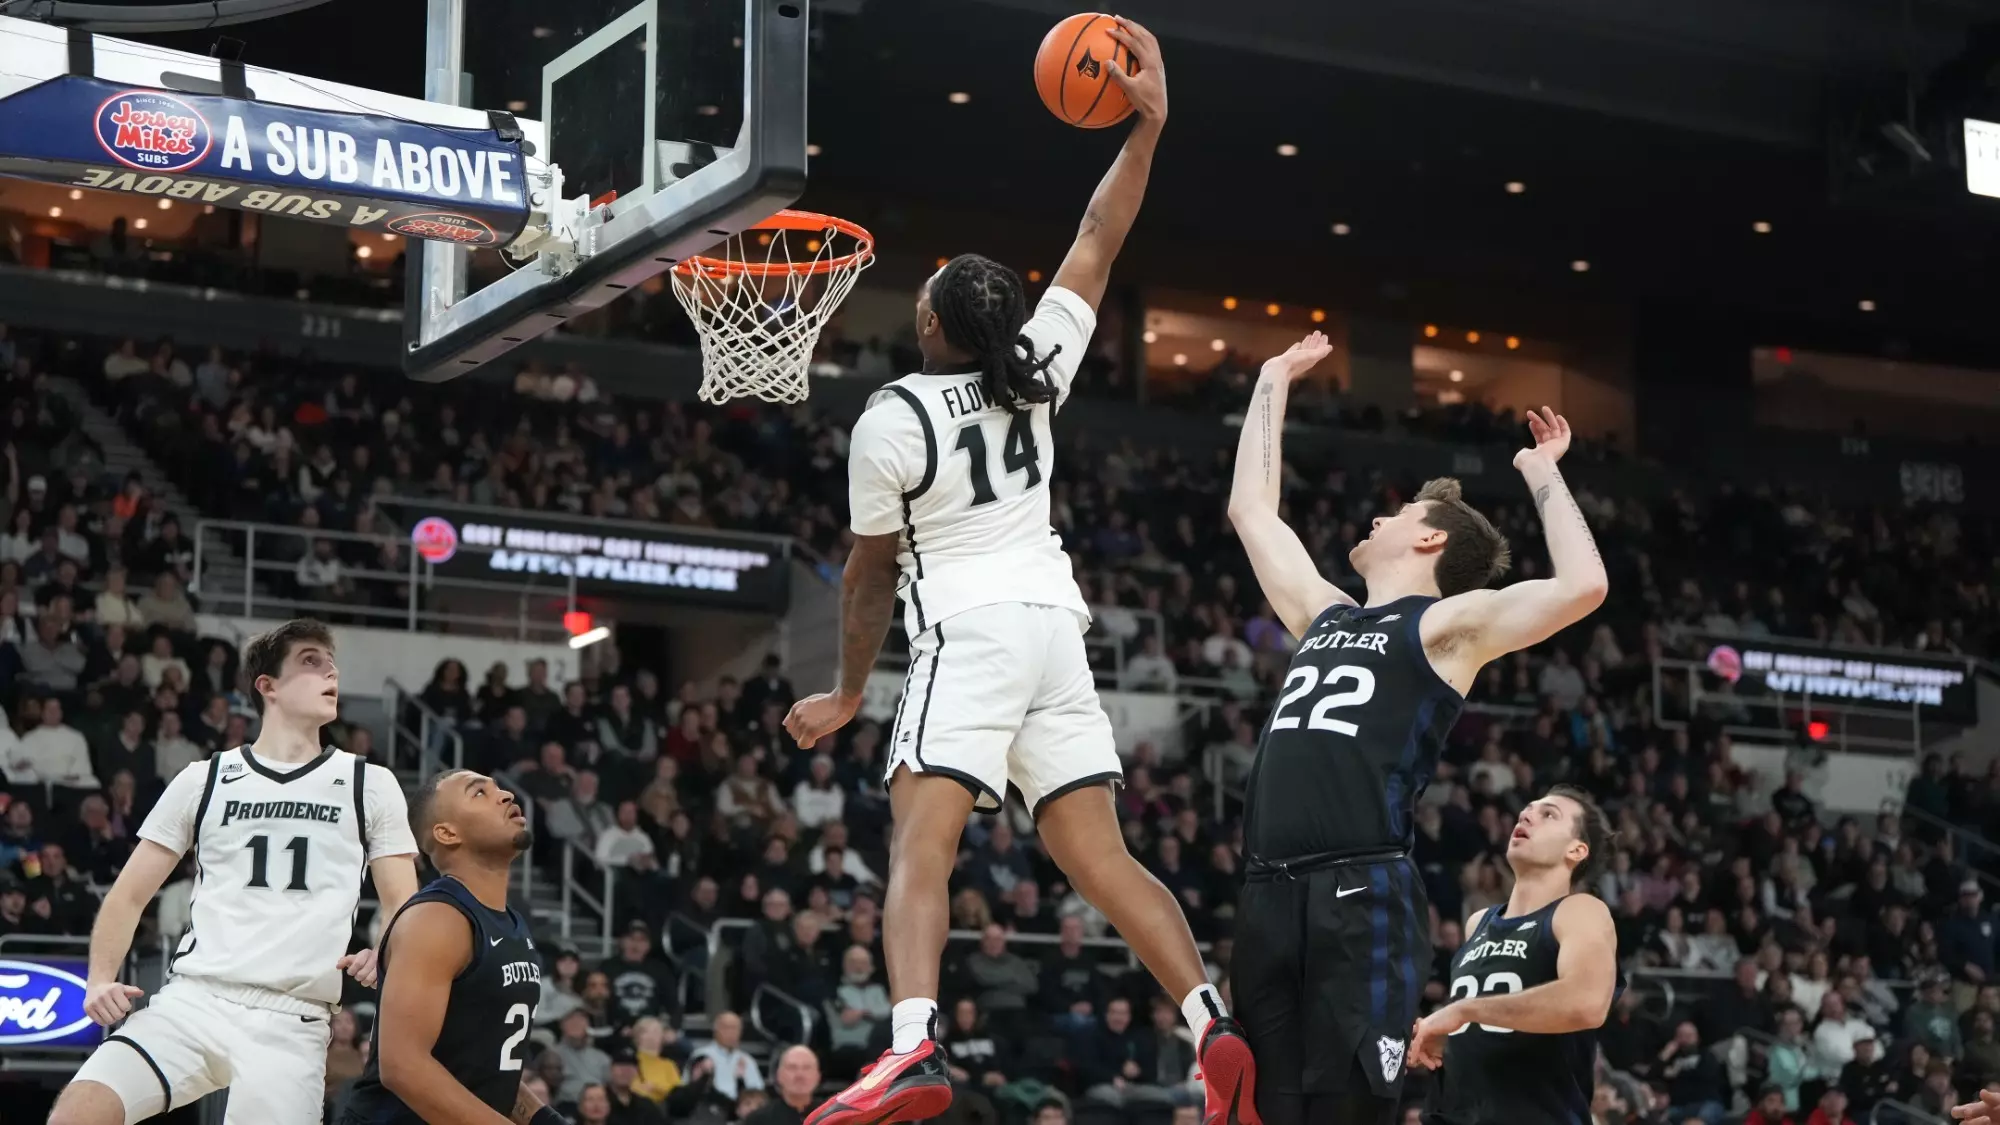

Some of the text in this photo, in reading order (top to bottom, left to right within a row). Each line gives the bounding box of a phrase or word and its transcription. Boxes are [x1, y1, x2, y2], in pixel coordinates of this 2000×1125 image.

[111, 101, 196, 138] Jersey
[137, 152, 168, 165] SUBS
[221, 115, 517, 202] A SUB ABOVE
[73, 168, 389, 225] A SUB ABOVE
[953, 408, 1043, 508] 14
[1296, 630, 1389, 656] BUTLER
[1270, 664, 1375, 737] 22
[219, 800, 342, 827] PROVIDENCE
[243, 833, 311, 892] 11
[1459, 939, 1528, 968] BUTLER
[499, 1003, 539, 1071] 2
